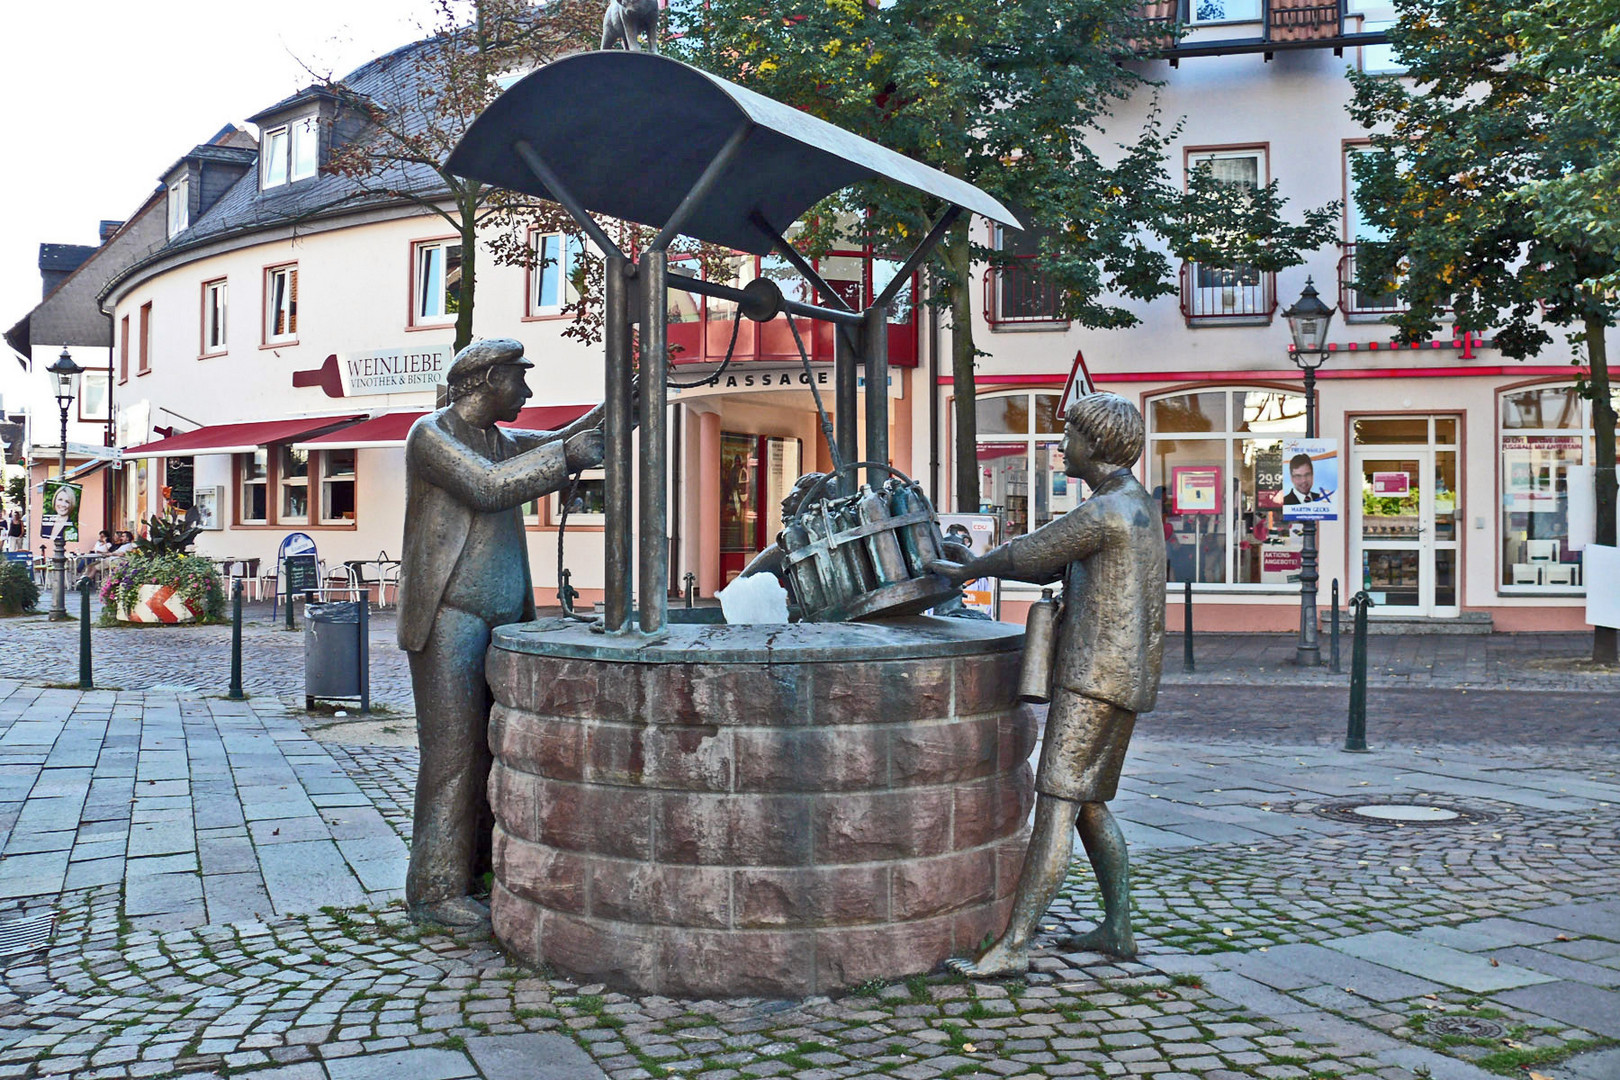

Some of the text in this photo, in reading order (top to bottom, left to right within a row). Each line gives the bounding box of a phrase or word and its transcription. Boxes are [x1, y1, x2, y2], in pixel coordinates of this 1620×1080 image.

[347, 353, 443, 377] WEINLIEBE
[350, 373, 441, 388] VINOTHEK & BISTRO
[709, 372, 828, 388] PASSAGE
[1258, 473, 1282, 486] 29,9
